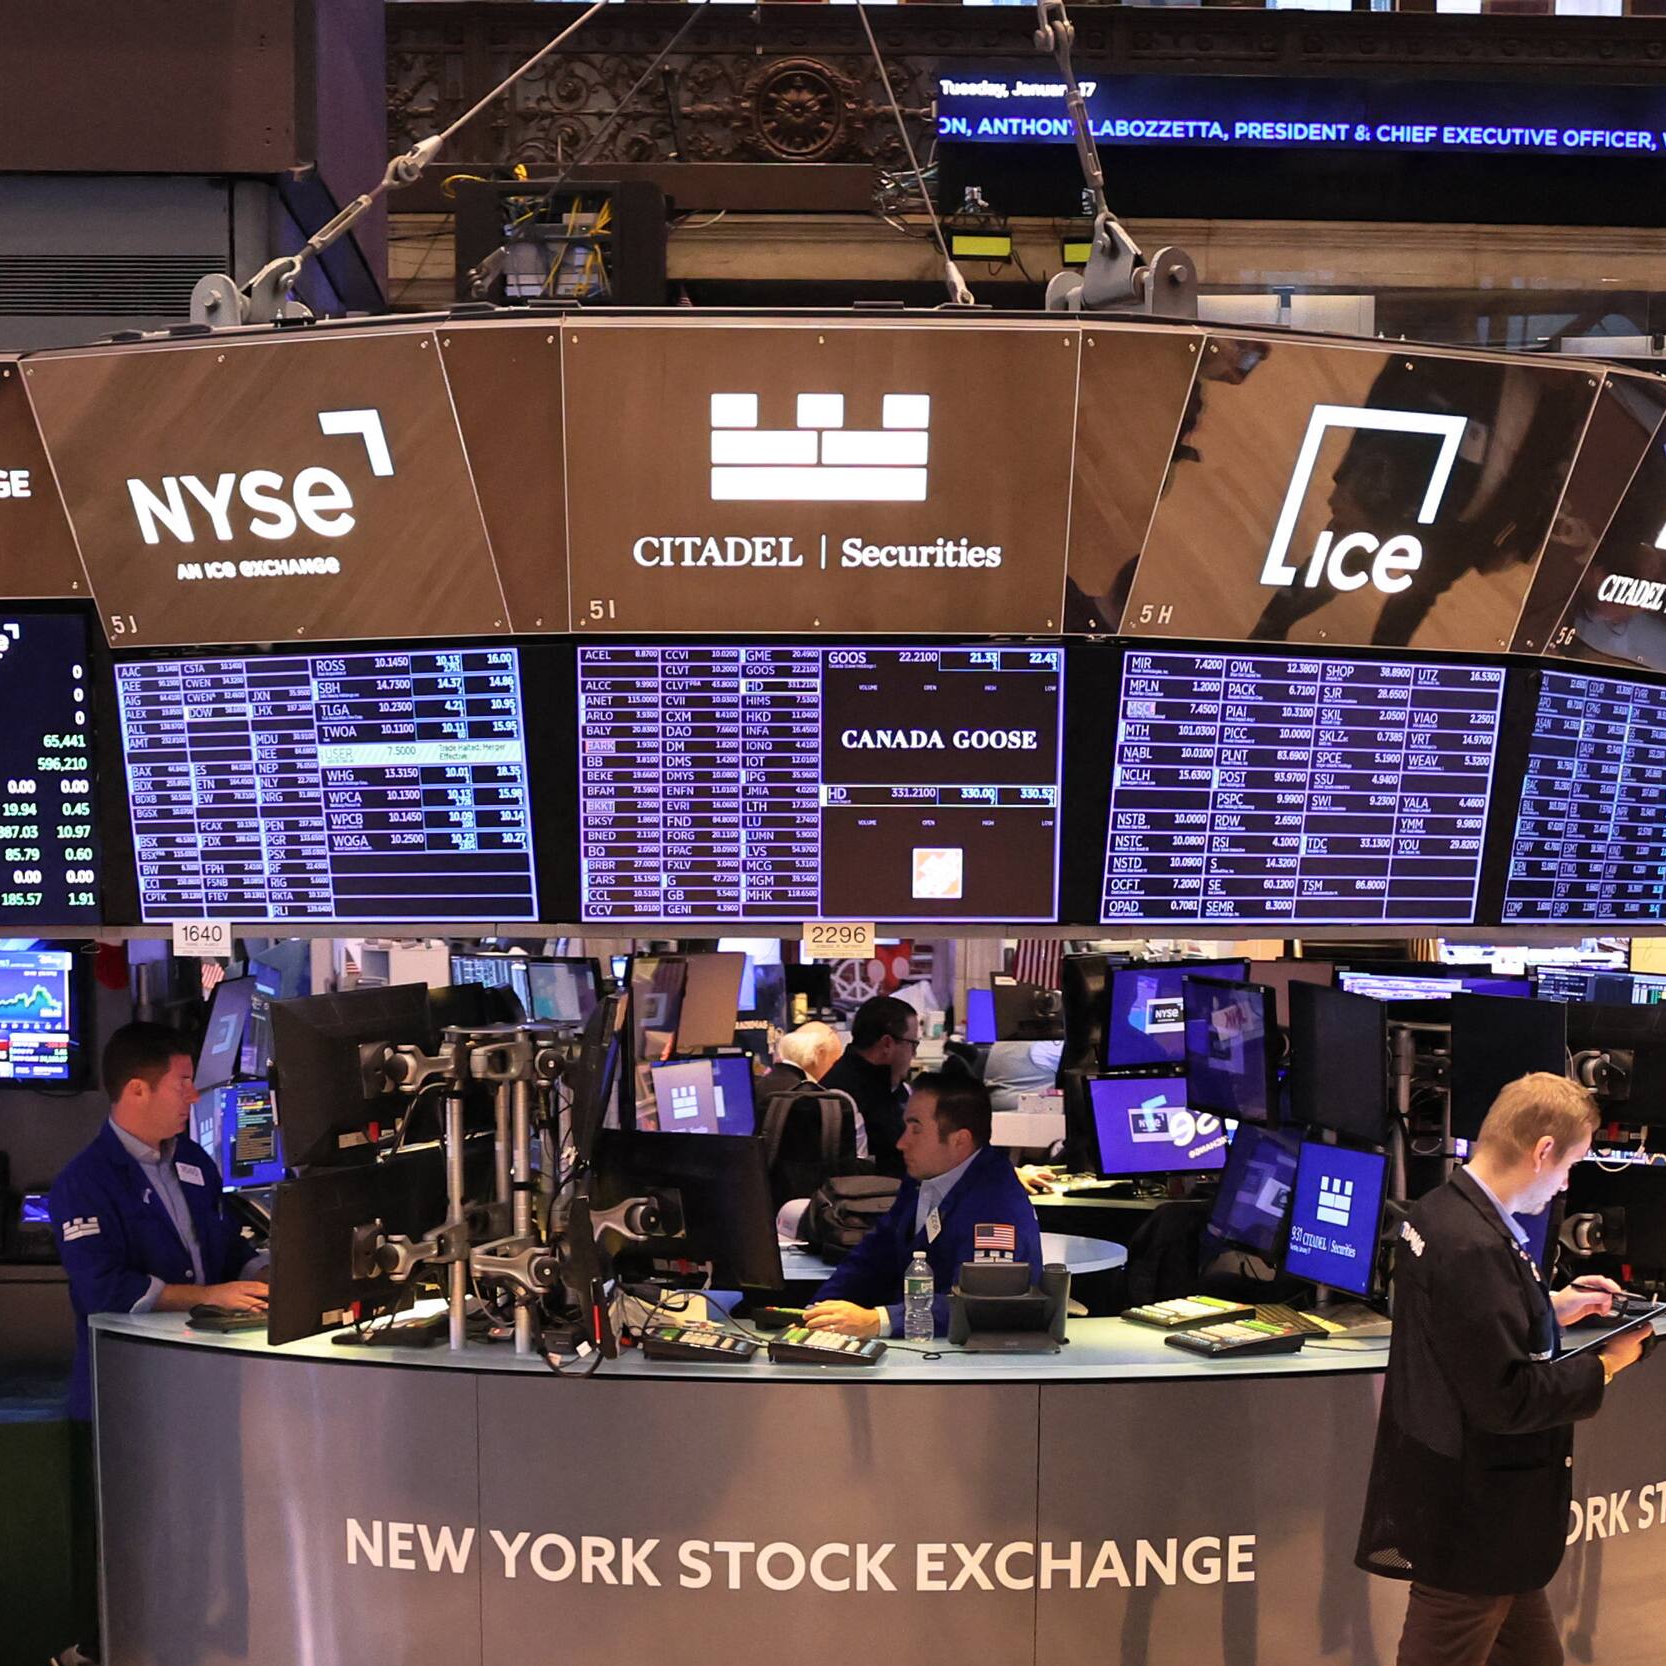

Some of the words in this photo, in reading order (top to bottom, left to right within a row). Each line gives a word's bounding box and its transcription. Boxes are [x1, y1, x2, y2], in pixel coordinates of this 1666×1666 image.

[940, 80, 1009, 98] Tuesday,
[1011, 81, 1068, 97] Januar
[1078, 81, 1097, 98] 17
[1090, 119, 1231, 142] LABOZZETTA,
[1235, 122, 1349, 140] PRESIDENT
[1355, 124, 1370, 141] &
[1377, 125, 1437, 142] CHIEF
[1442, 126, 1558, 146] EXECUTIVE
[1563, 130, 1656, 151] OFFICER,
[633, 537, 803, 566] CITADEL
[842, 538, 1001, 567] Securities
[178, 564, 203, 580] AN
[1598, 574, 1664, 612] CITADEL
[317, 660, 345, 670] ROSS
[374, 657, 408, 667] 10.1450
[827, 650, 868, 666] GOOS
[898, 651, 938, 664] 22.2100
[1131, 655, 1152, 670] MIR
[1192, 658, 1223, 671] 7.4200
[43, 734, 86, 750] 65,441
[842, 730, 945, 748] CANADA
[953, 731, 1037, 749] GOOSE
[37, 757, 88, 772] 596,210
[327, 770, 354, 781] WHG
[2, 803, 37, 817] 19.94
[62, 803, 90, 817] 0.45
[1, 892, 42, 906] 185.57
[68, 892, 95, 906] 1.91
[182, 926, 222, 941] 1640
[809, 924, 868, 946] 2296
[347, 1518, 475, 1573] NEW
[489, 1530, 661, 1586] YORK
[679, 1540, 897, 1591] STOCK
[917, 1535, 1255, 1591] EXCHANGE
